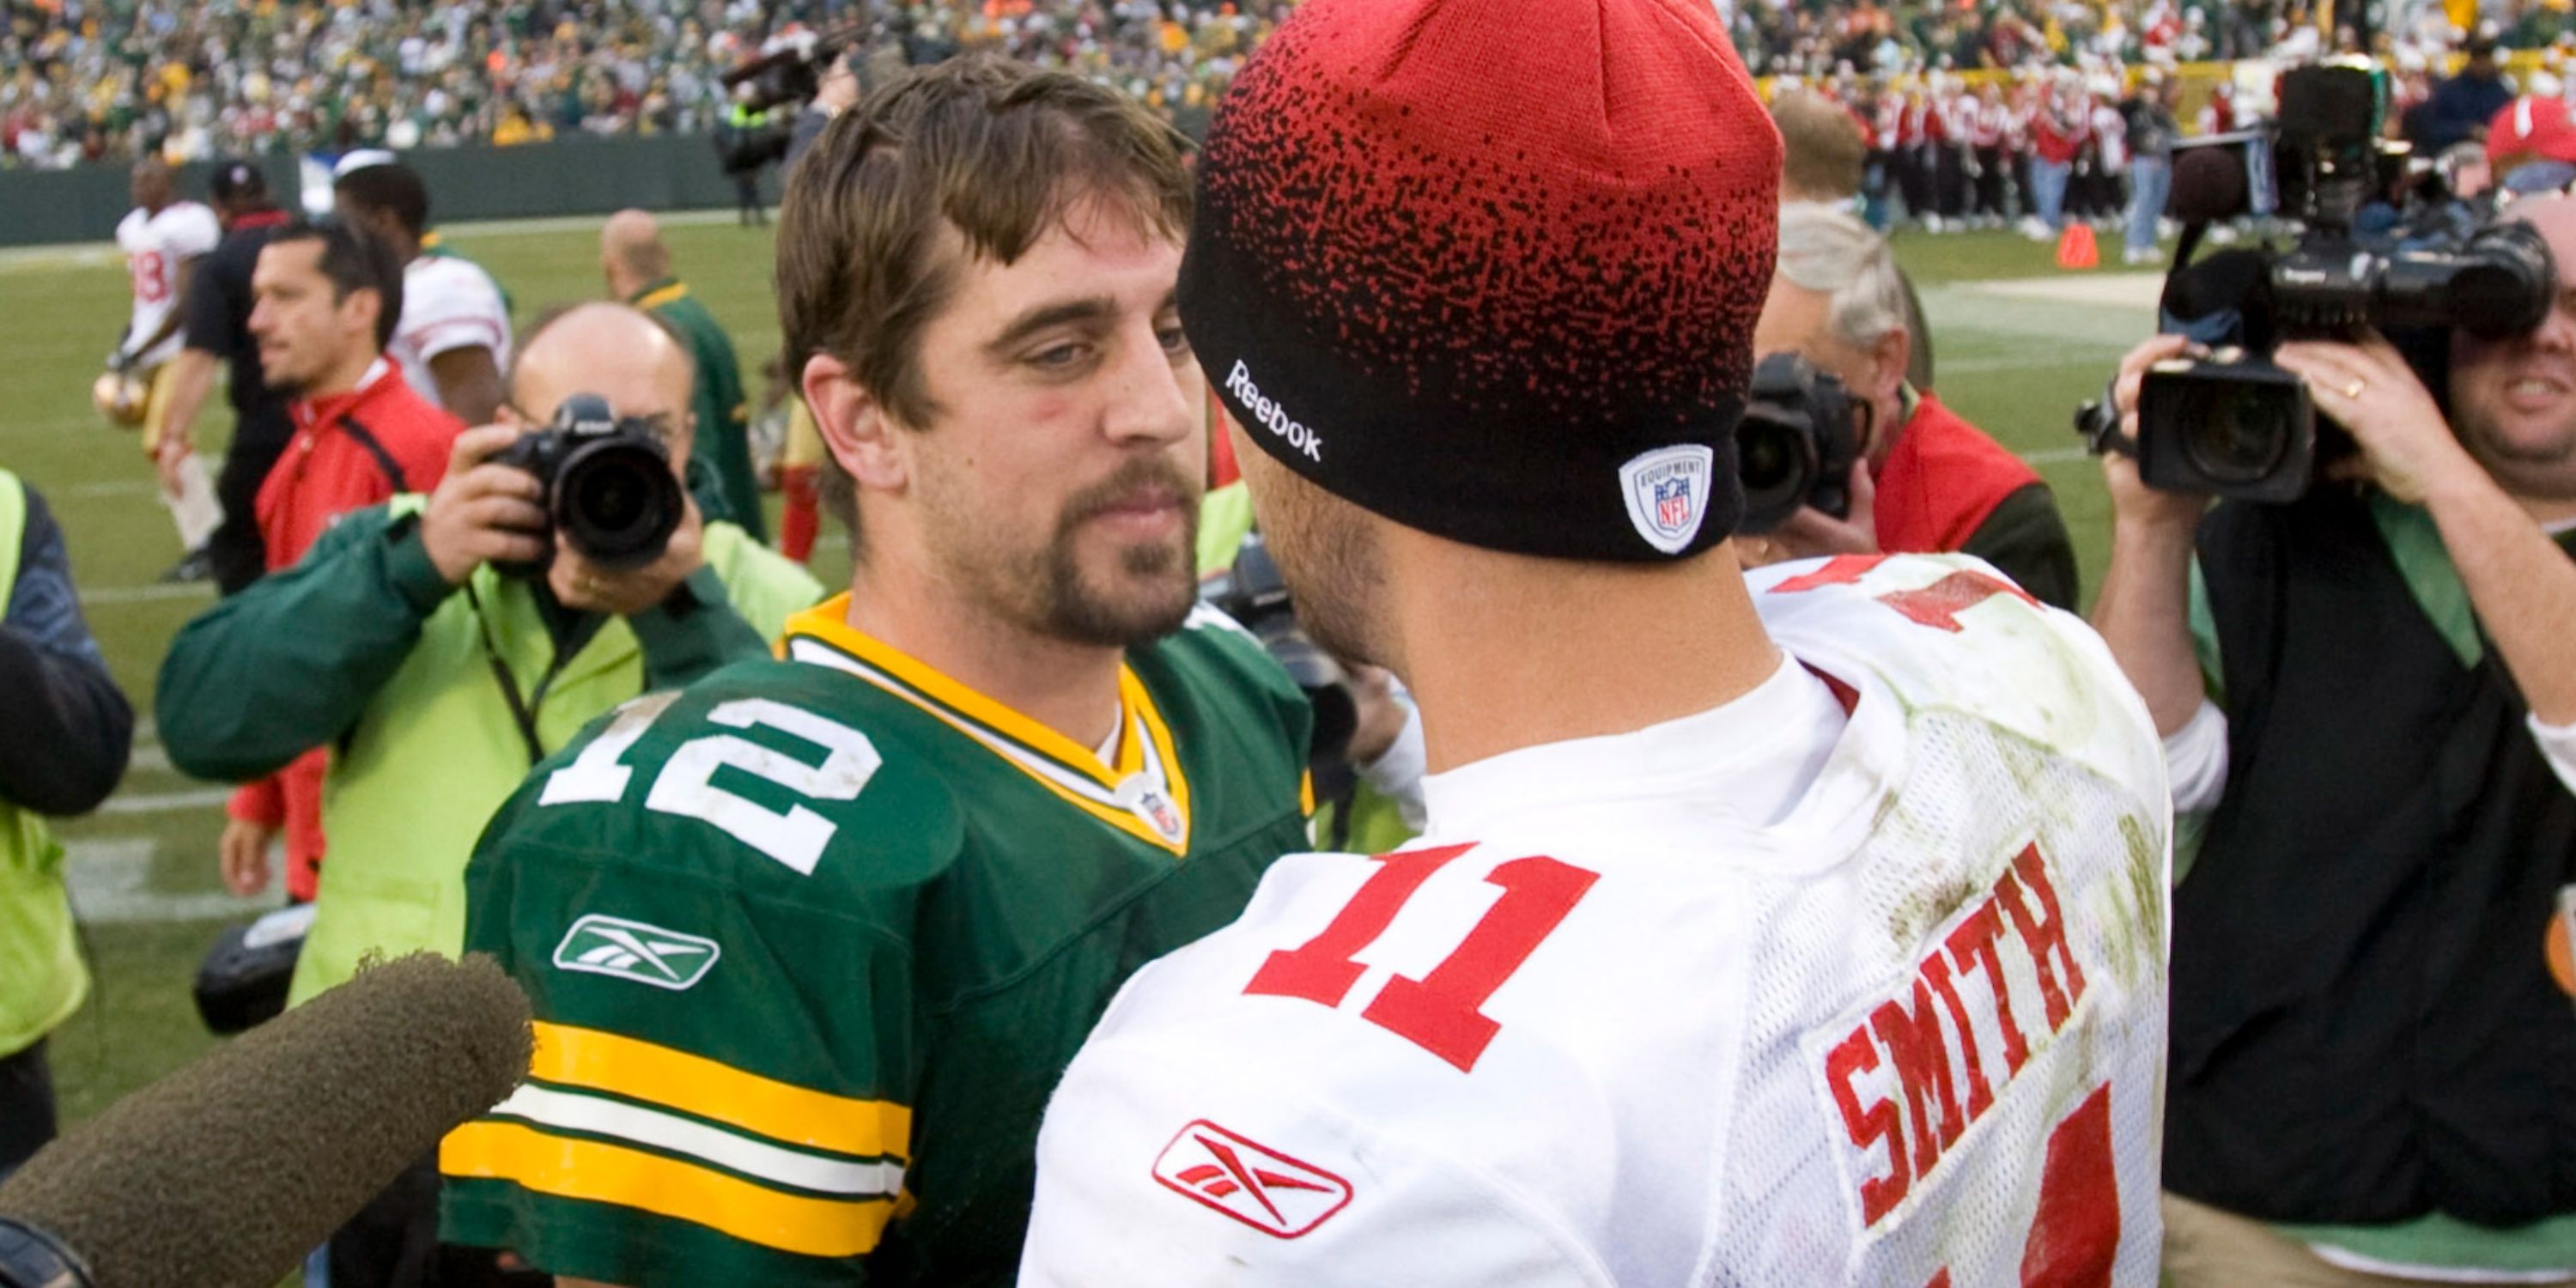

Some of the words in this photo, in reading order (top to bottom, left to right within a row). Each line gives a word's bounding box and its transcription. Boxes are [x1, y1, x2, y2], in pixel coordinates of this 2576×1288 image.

[1225, 359, 1322, 462] Reebok
[1641, 459, 1701, 487] EQUIPMENT
[1657, 496, 1691, 526] NFL
[538, 690, 884, 876] 12
[1242, 841, 1602, 1074] 11
[1826, 841, 2087, 1228] SMITH
